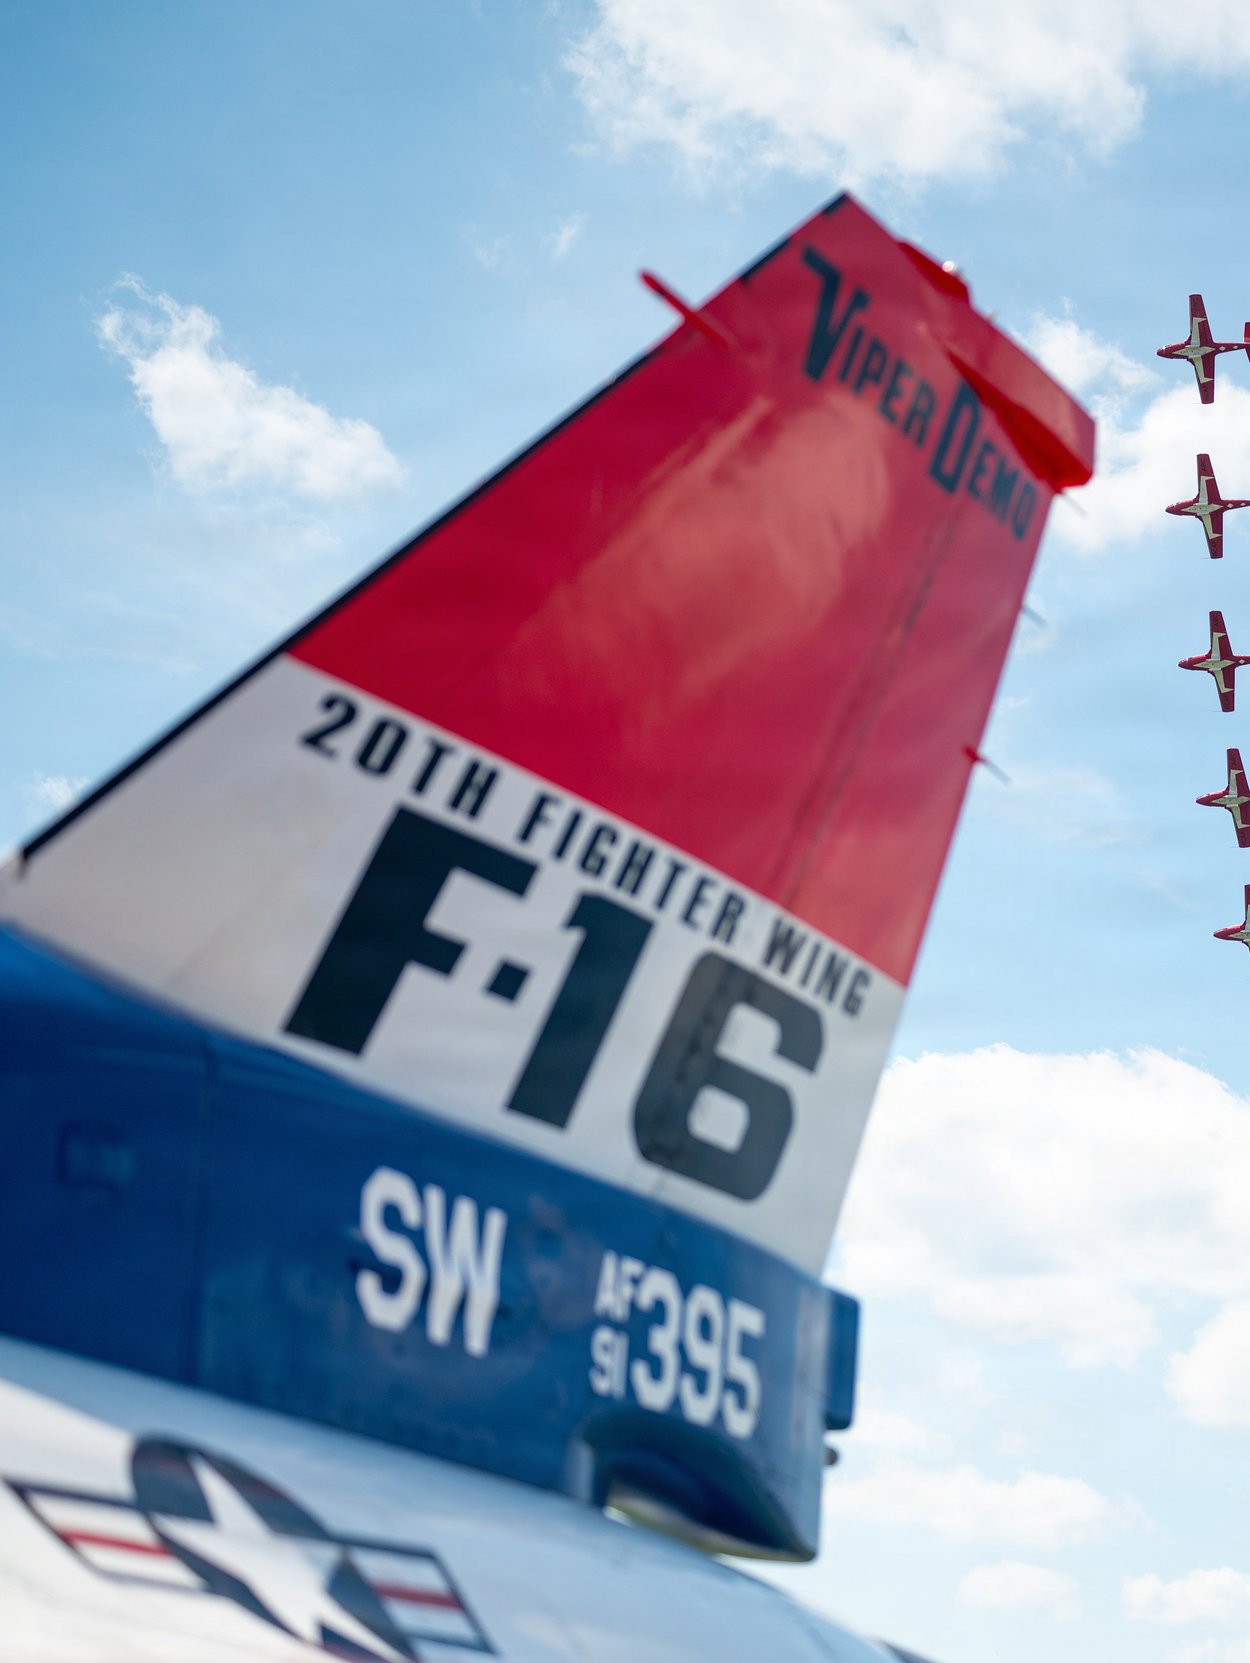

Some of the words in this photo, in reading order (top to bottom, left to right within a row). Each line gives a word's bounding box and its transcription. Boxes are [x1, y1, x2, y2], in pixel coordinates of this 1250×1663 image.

[801, 244, 937, 449] VIPER
[928, 378, 1040, 543] DEMO
[298, 692, 501, 822] 20TH
[514, 789, 749, 946] FIGHTER
[761, 914, 873, 1019] WING
[355, 1164, 508, 1359] SW
[593, 1248, 644, 1323] AF
[629, 1265, 766, 1441] 395
